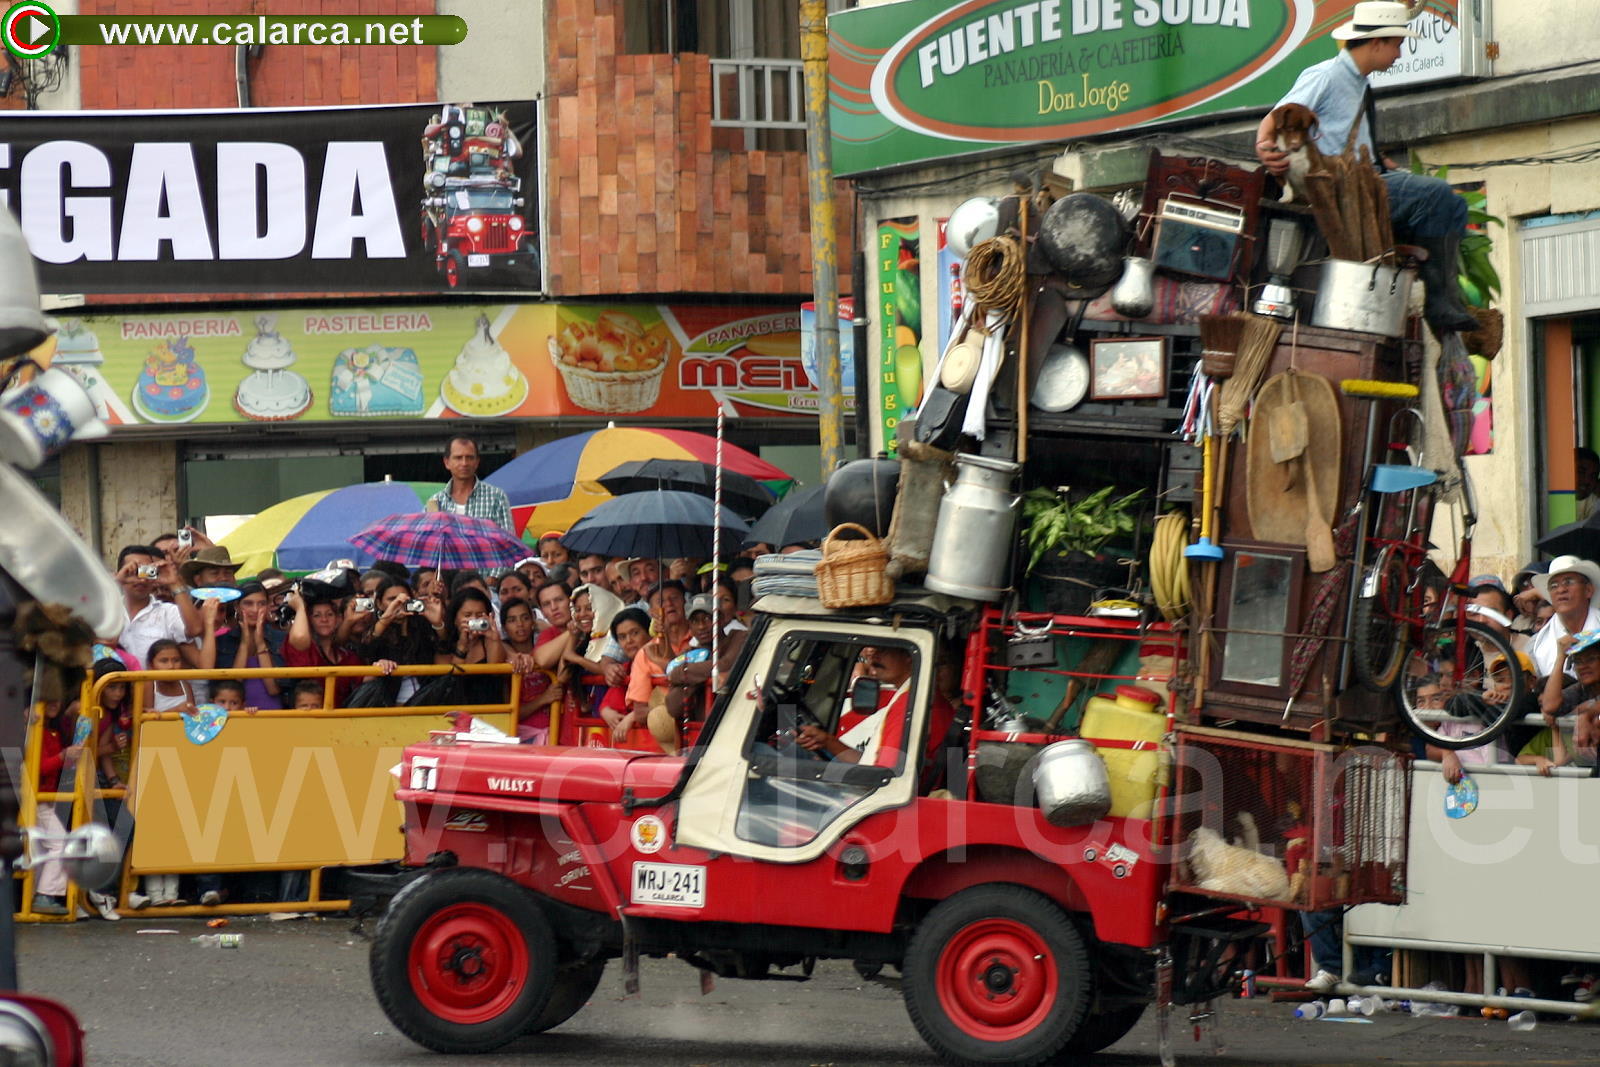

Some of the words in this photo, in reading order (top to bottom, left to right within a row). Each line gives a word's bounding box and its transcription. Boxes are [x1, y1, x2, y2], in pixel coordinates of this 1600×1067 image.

[918, 0, 1062, 89] FUENTE
[1072, 0, 1123, 35] DE
[1133, 0, 1251, 29] SODA
[983, 46, 1076, 89] PANADERÍA
[1078, 47, 1095, 73] &
[1099, 31, 1186, 69] CAFETERÍA
[1038, 80, 1075, 115] Don
[1079, 73, 1131, 112] Jorge
[0, 139, 407, 264] GADA
[122, 318, 240, 338] PANADERIA
[304, 314, 431, 333] PASTELERIA
